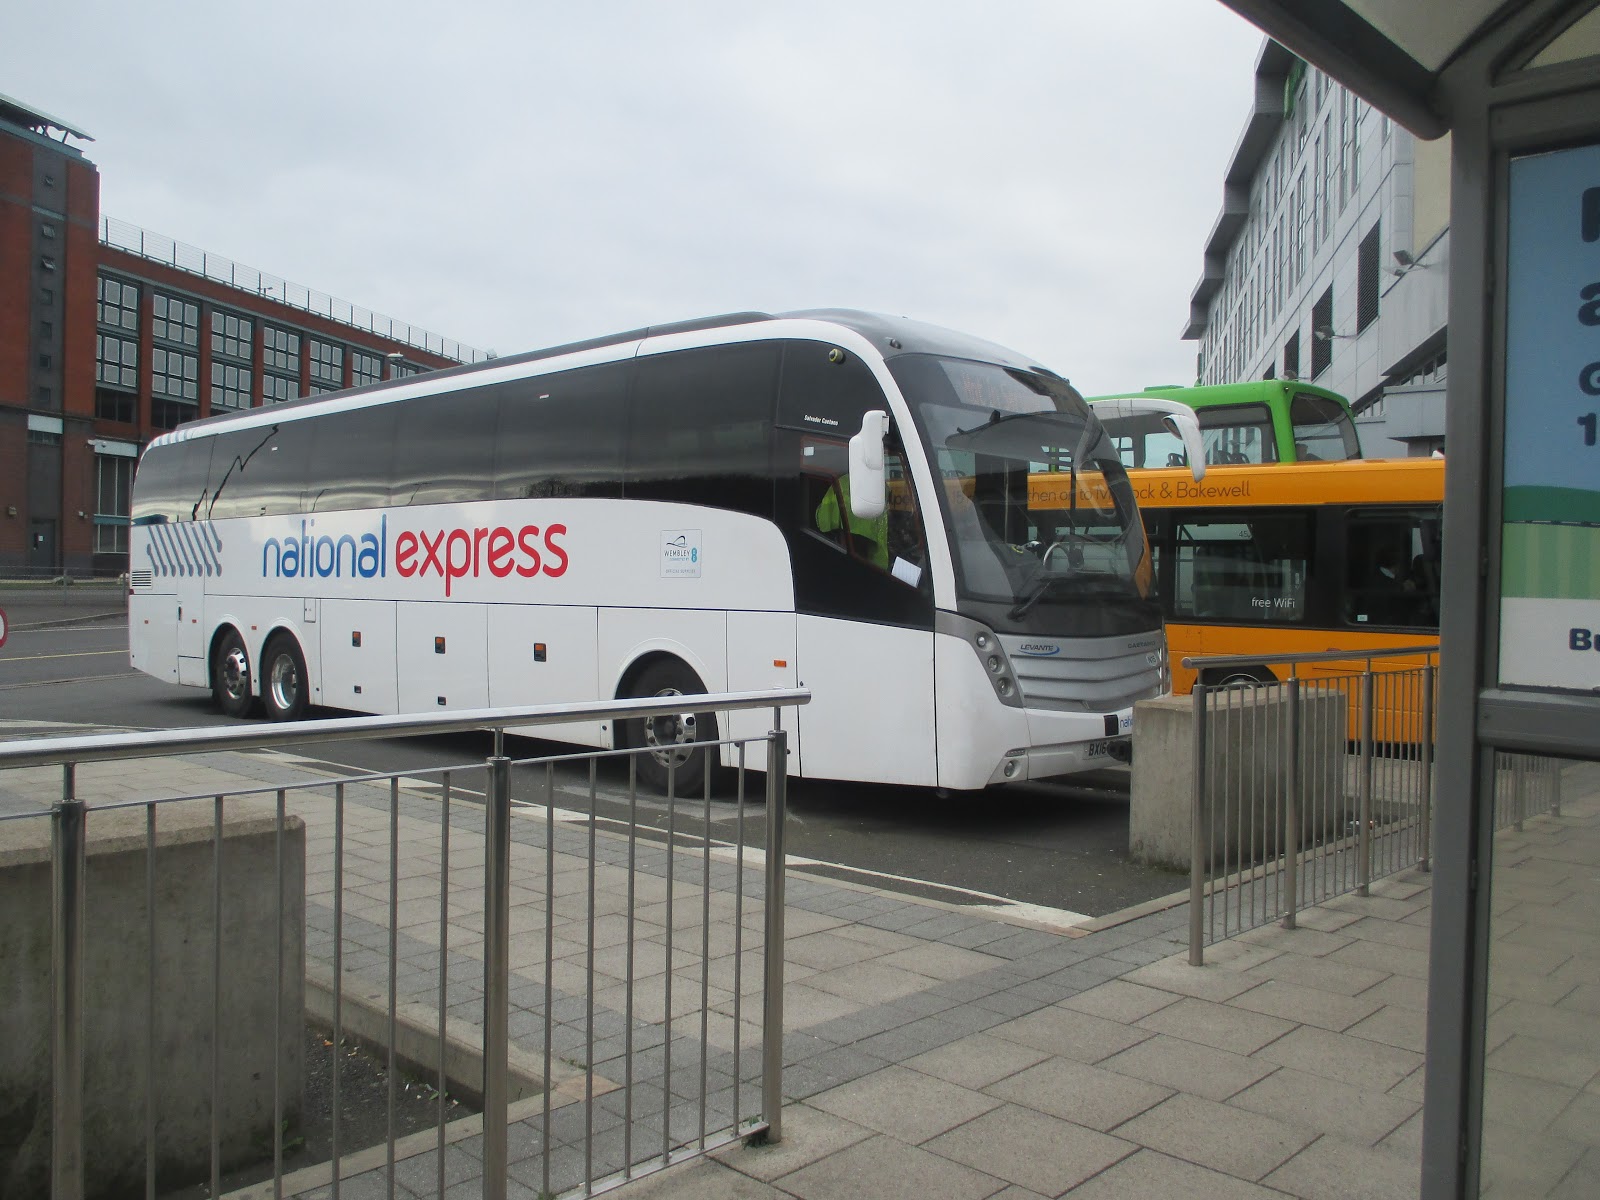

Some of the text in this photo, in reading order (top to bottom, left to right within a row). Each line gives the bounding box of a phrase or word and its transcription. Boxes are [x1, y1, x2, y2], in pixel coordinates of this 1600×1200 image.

[1079, 488, 1093, 501] to
[1096, 483, 1155, 500] Mock
[1160, 482, 1173, 499] &
[1177, 480, 1251, 498] Bakewell
[262, 513, 569, 597] national express
[664, 549, 690, 557] WEMBLEY
[1251, 597, 1295, 608] free WiFi
